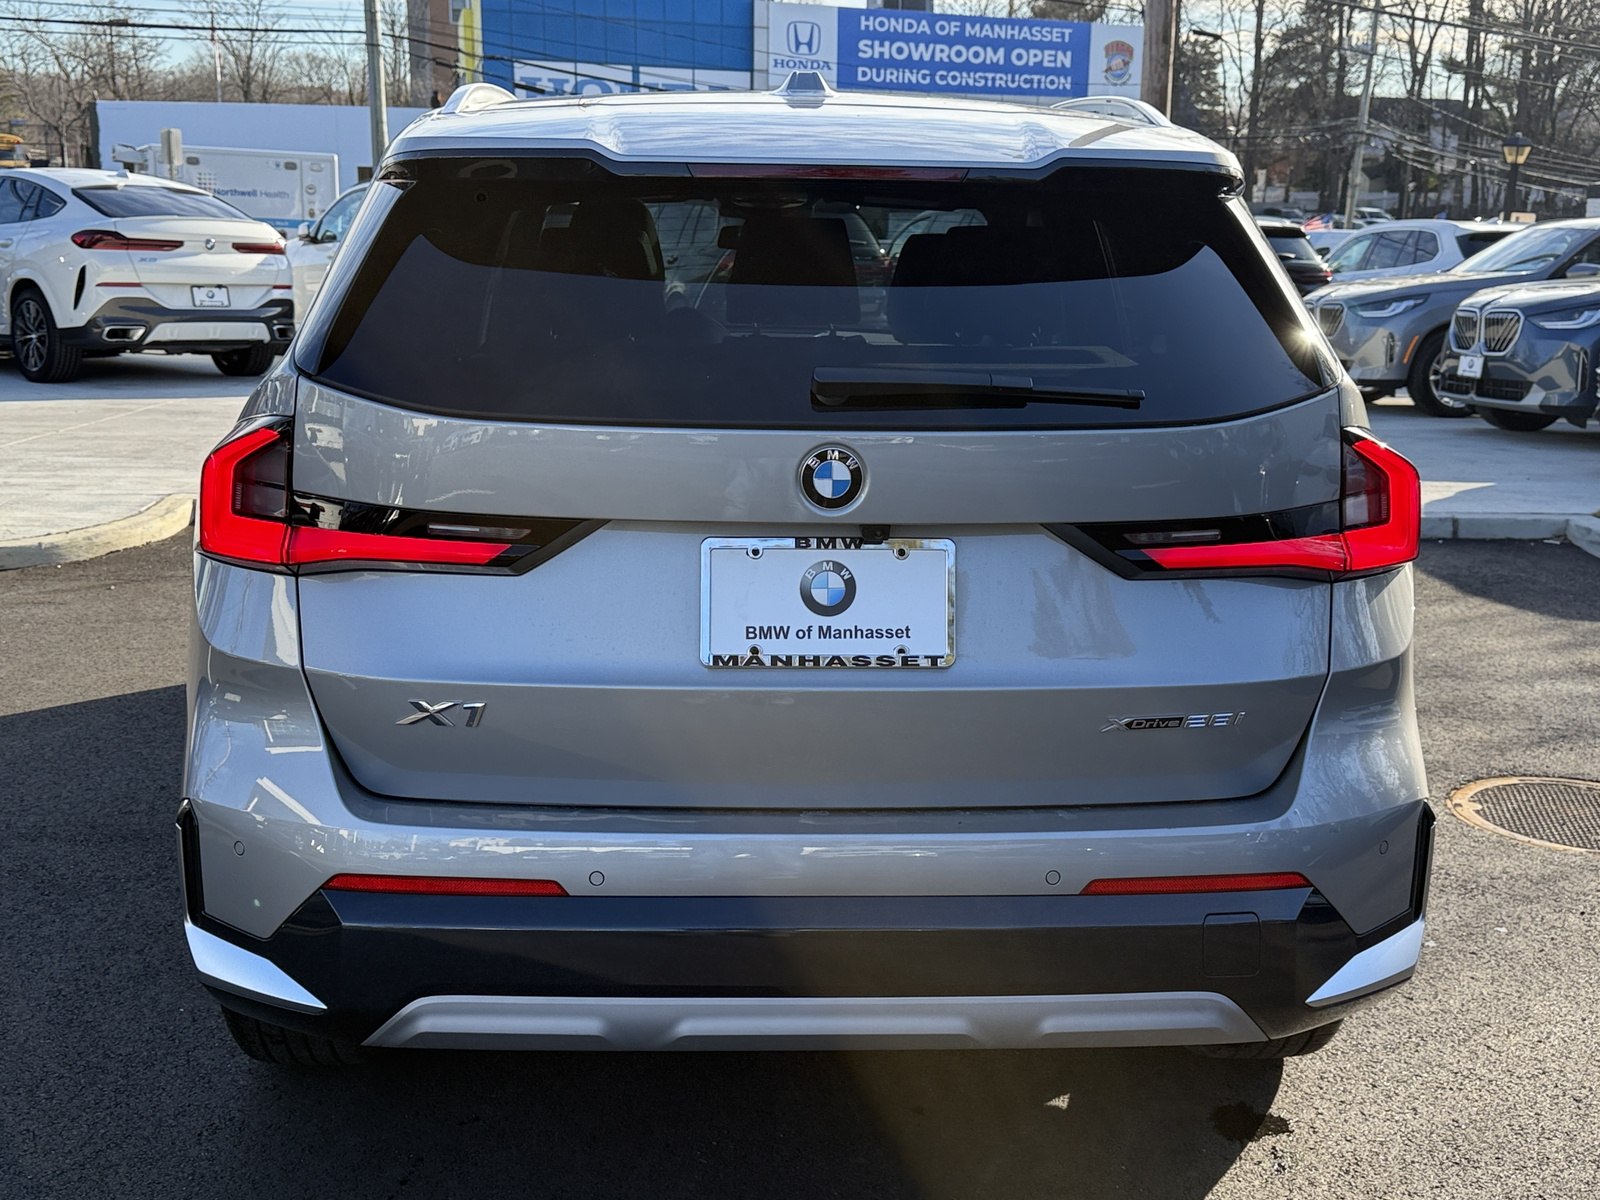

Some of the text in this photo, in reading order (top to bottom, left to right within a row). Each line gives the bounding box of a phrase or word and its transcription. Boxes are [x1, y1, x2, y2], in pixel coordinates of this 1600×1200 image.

[860, 15, 1073, 43] HONDA OF MANHASSET
[857, 39, 1072, 68] SHOWROOM OPEN
[773, 58, 832, 70] HONDA
[857, 66, 1072, 90] DURING CONSTRUCTION
[213, 187, 290, 199] Northwell Health
[807, 449, 860, 471] BMW
[794, 537, 863, 550] BMW
[804, 561, 853, 581] BMW
[745, 625, 911, 640] BMW of Manhasset
[712, 655, 946, 667] MANHASSET
[395, 699, 486, 727] X1
